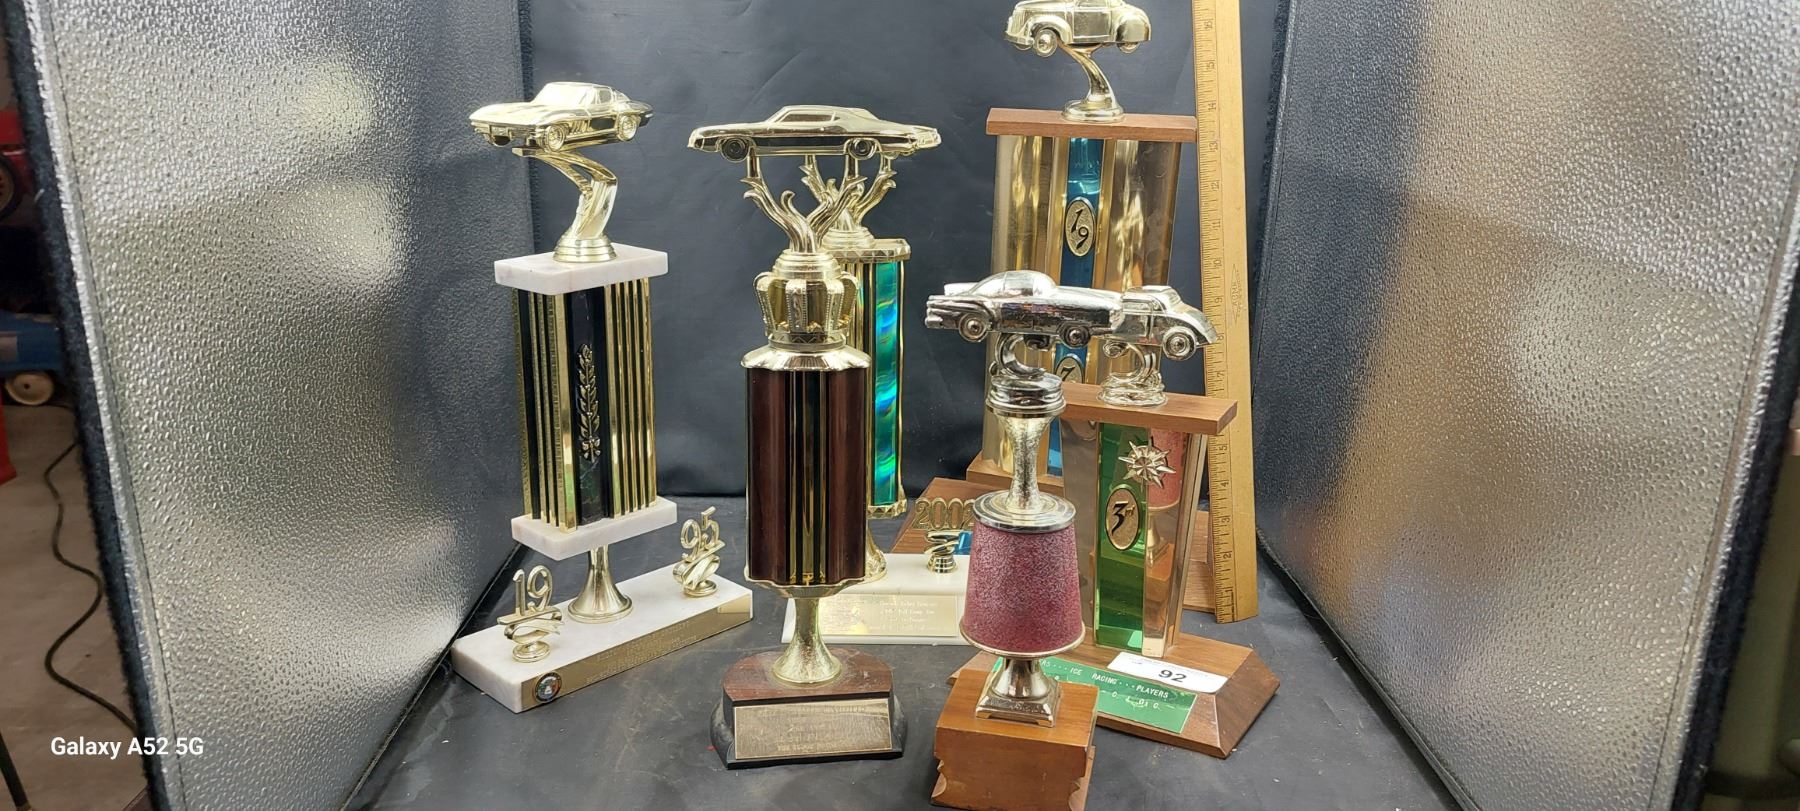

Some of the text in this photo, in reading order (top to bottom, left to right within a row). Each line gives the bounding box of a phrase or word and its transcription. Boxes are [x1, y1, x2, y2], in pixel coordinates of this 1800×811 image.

[1070, 207, 1089, 250] 19
[680, 506, 720, 562] 95
[512, 565, 553, 616] 19
[1069, 667, 1084, 676] ICE
[1091, 672, 1119, 685] RACING
[1135, 684, 1170, 699] PLAYERS
[1157, 669, 1188, 683] 92
